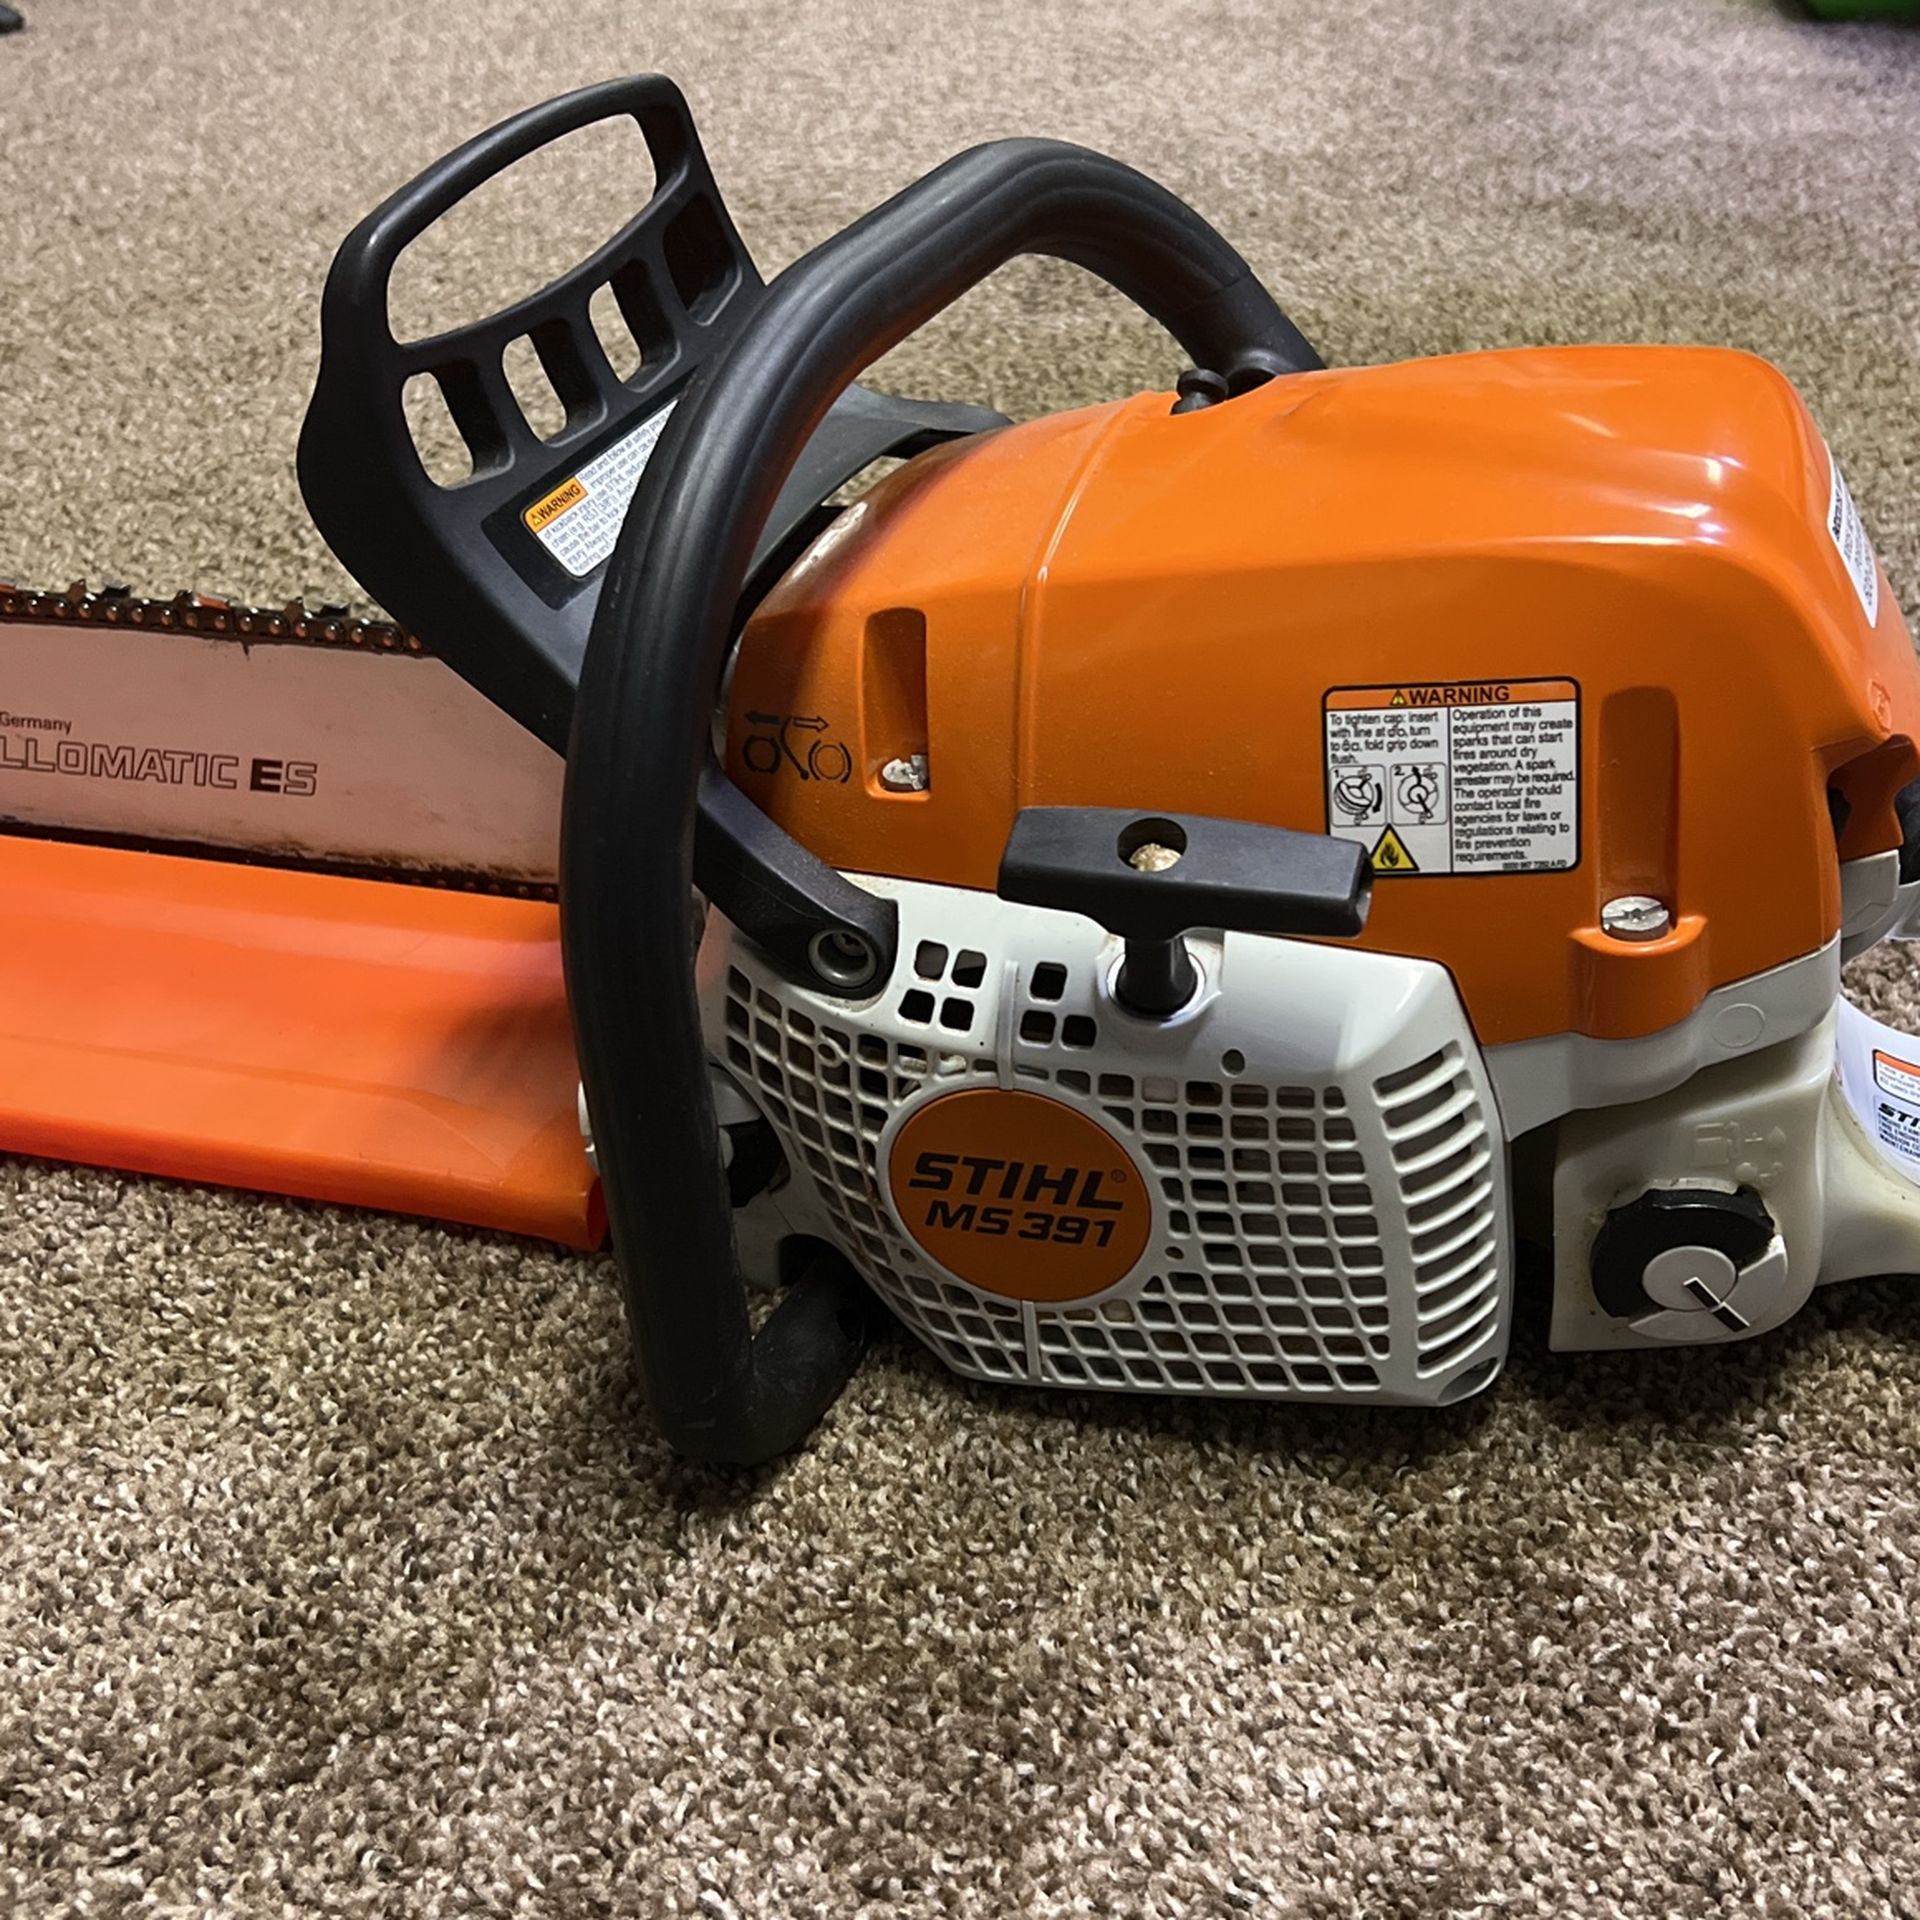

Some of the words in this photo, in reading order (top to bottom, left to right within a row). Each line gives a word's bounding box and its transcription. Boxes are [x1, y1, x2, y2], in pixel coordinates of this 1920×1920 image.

[538, 484, 581, 520] WARNING
[1409, 685, 1510, 705] WARNING
[0, 711, 72, 734] Germany
[1330, 714, 1342, 725] To
[1345, 714, 1380, 728] tighten
[1408, 711, 1439, 723] insert
[1453, 708, 1506, 722] Operation
[1509, 706, 1520, 718] of
[1522, 706, 1542, 717] this
[1330, 728, 1351, 738] with
[1354, 727, 1372, 738] line
[1375, 727, 1386, 737] at
[1410, 726, 1431, 736] turn
[1453, 722, 1510, 735] equipment
[1512, 721, 1536, 733] may
[1539, 718, 1573, 730] create
[1330, 741, 1340, 751] to
[1365, 739, 1384, 750] fold
[1386, 740, 1407, 753] grip
[1410, 738, 1439, 749] down
[1453, 735, 1488, 748] sparks
[1491, 734, 1512, 745] that
[1515, 735, 1535, 744] can
[1538, 732, 1563, 743] start
[1453, 749, 1476, 760] fires
[1479, 747, 1517, 759] around
[1520, 746, 1537, 759] dry
[0, 735, 239, 790] LLOMATIC
[249, 757, 318, 797] ES
[1453, 761, 1512, 775] vegetation.
[1515, 760, 1523, 770] A
[1526, 758, 1556, 772] spark
[1454, 776, 1492, 786] arrester
[1493, 775, 1516, 789] may
[1517, 773, 1530, 783] be
[1532, 771, 1575, 783] required.
[1454, 787, 1475, 798] The
[1477, 787, 1523, 799] operator
[1526, 784, 1562, 795] should
[1454, 801, 1493, 812] contact
[1496, 799, 1520, 809] local
[1524, 797, 1541, 808] fire
[1454, 814, 1502, 827] agencies
[1506, 811, 1520, 822] for
[1523, 811, 1547, 821] laws
[1550, 811, 1562, 820] or
[1454, 826, 1513, 839] regulations
[1516, 823, 1556, 836] relating
[1559, 822, 1570, 833] to
[1455, 839, 1472, 849] fire
[1474, 837, 1531, 851] prevention
[1455, 851, 1528, 864] requirements.
[1879, 1102, 1920, 1128] STI
[908, 1151, 1124, 1212] STIHL
[924, 1200, 1014, 1236] MS
[1017, 1211, 1117, 1248] 391
